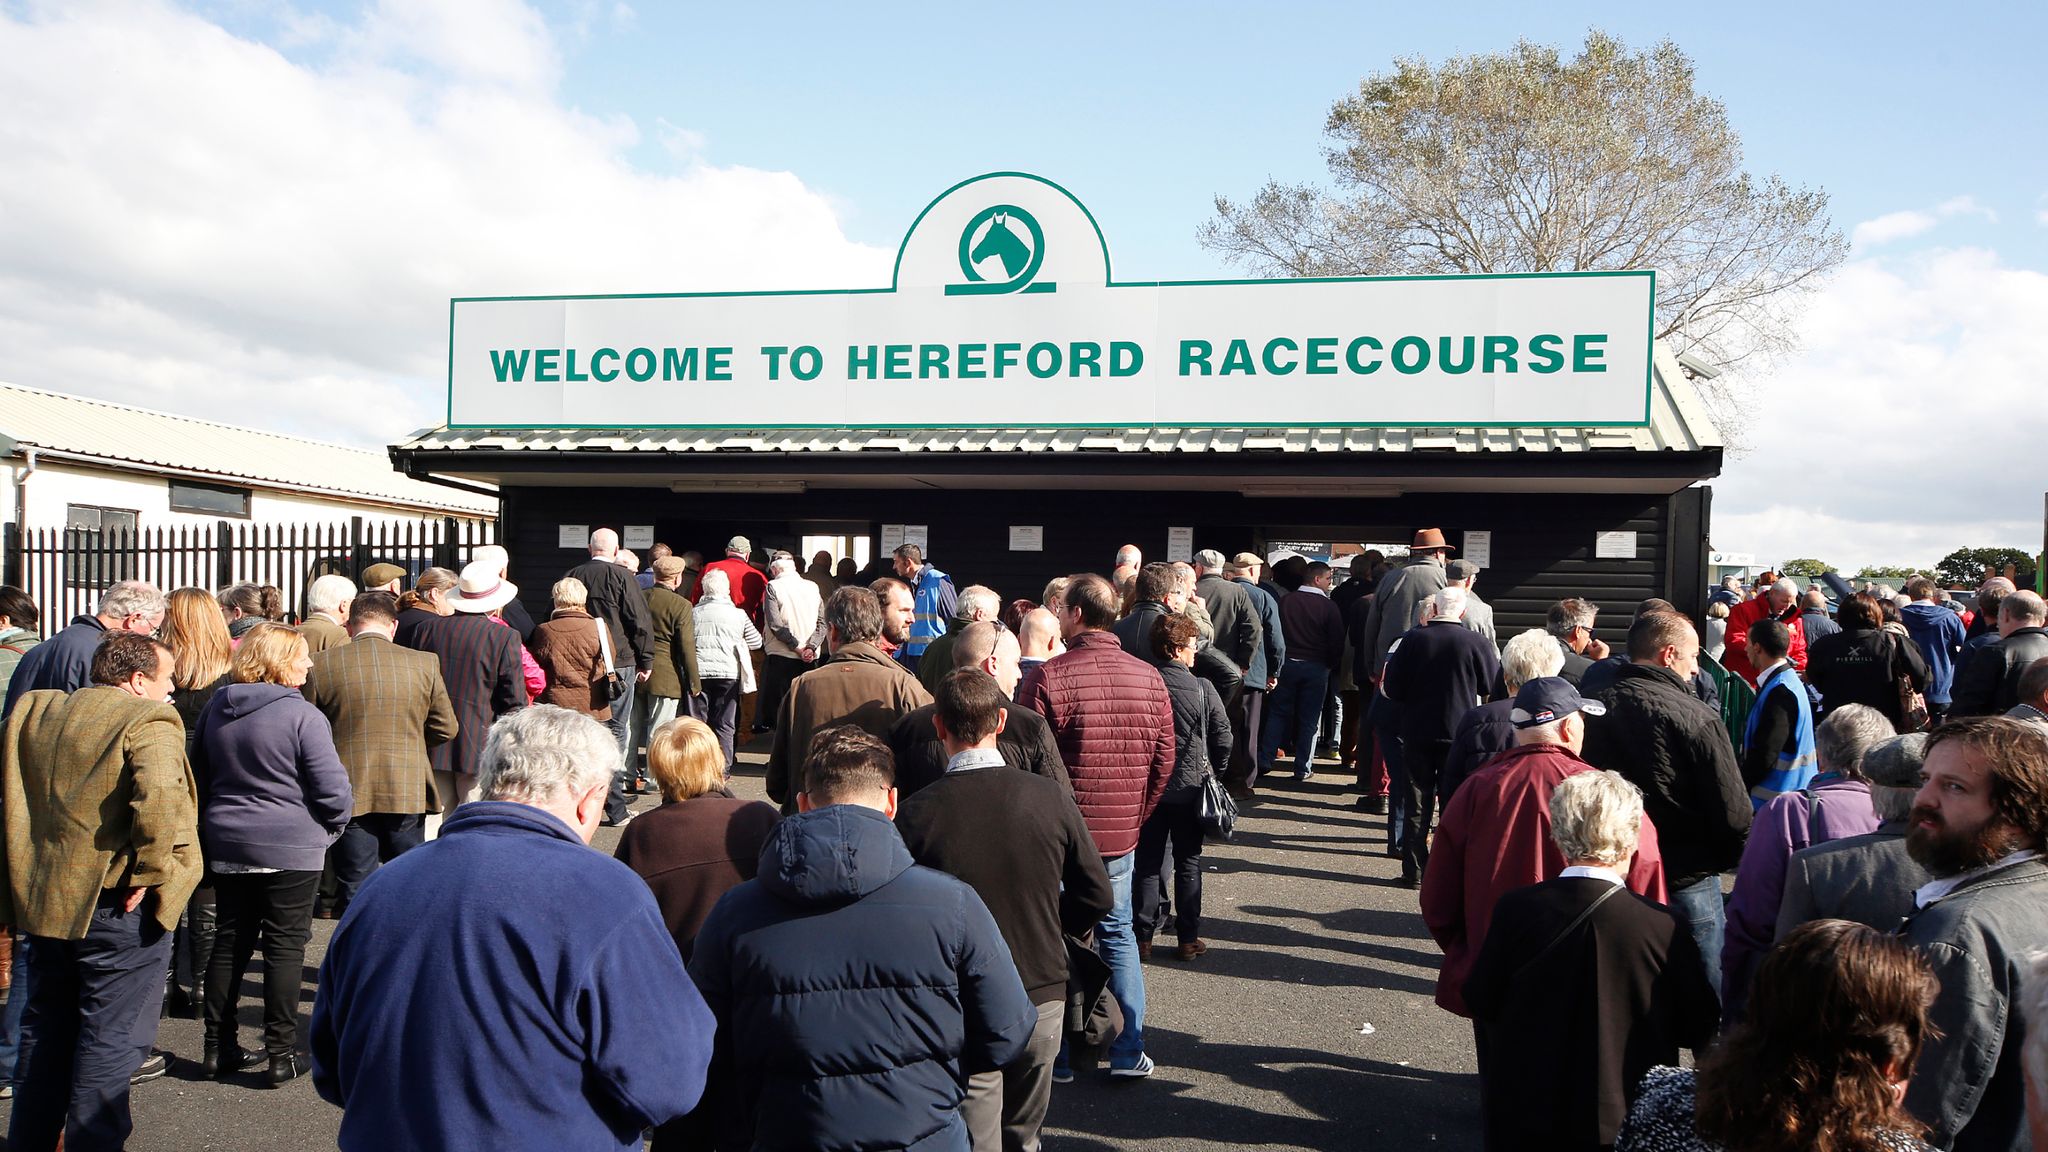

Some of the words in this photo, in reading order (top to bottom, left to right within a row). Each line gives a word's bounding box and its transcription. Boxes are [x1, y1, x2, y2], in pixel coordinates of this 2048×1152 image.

[490, 346, 734, 383] WELCOME
[761, 345, 824, 382] TO
[847, 341, 1144, 381] HEREFORD
[1179, 333, 1608, 377] RACECOURSE
